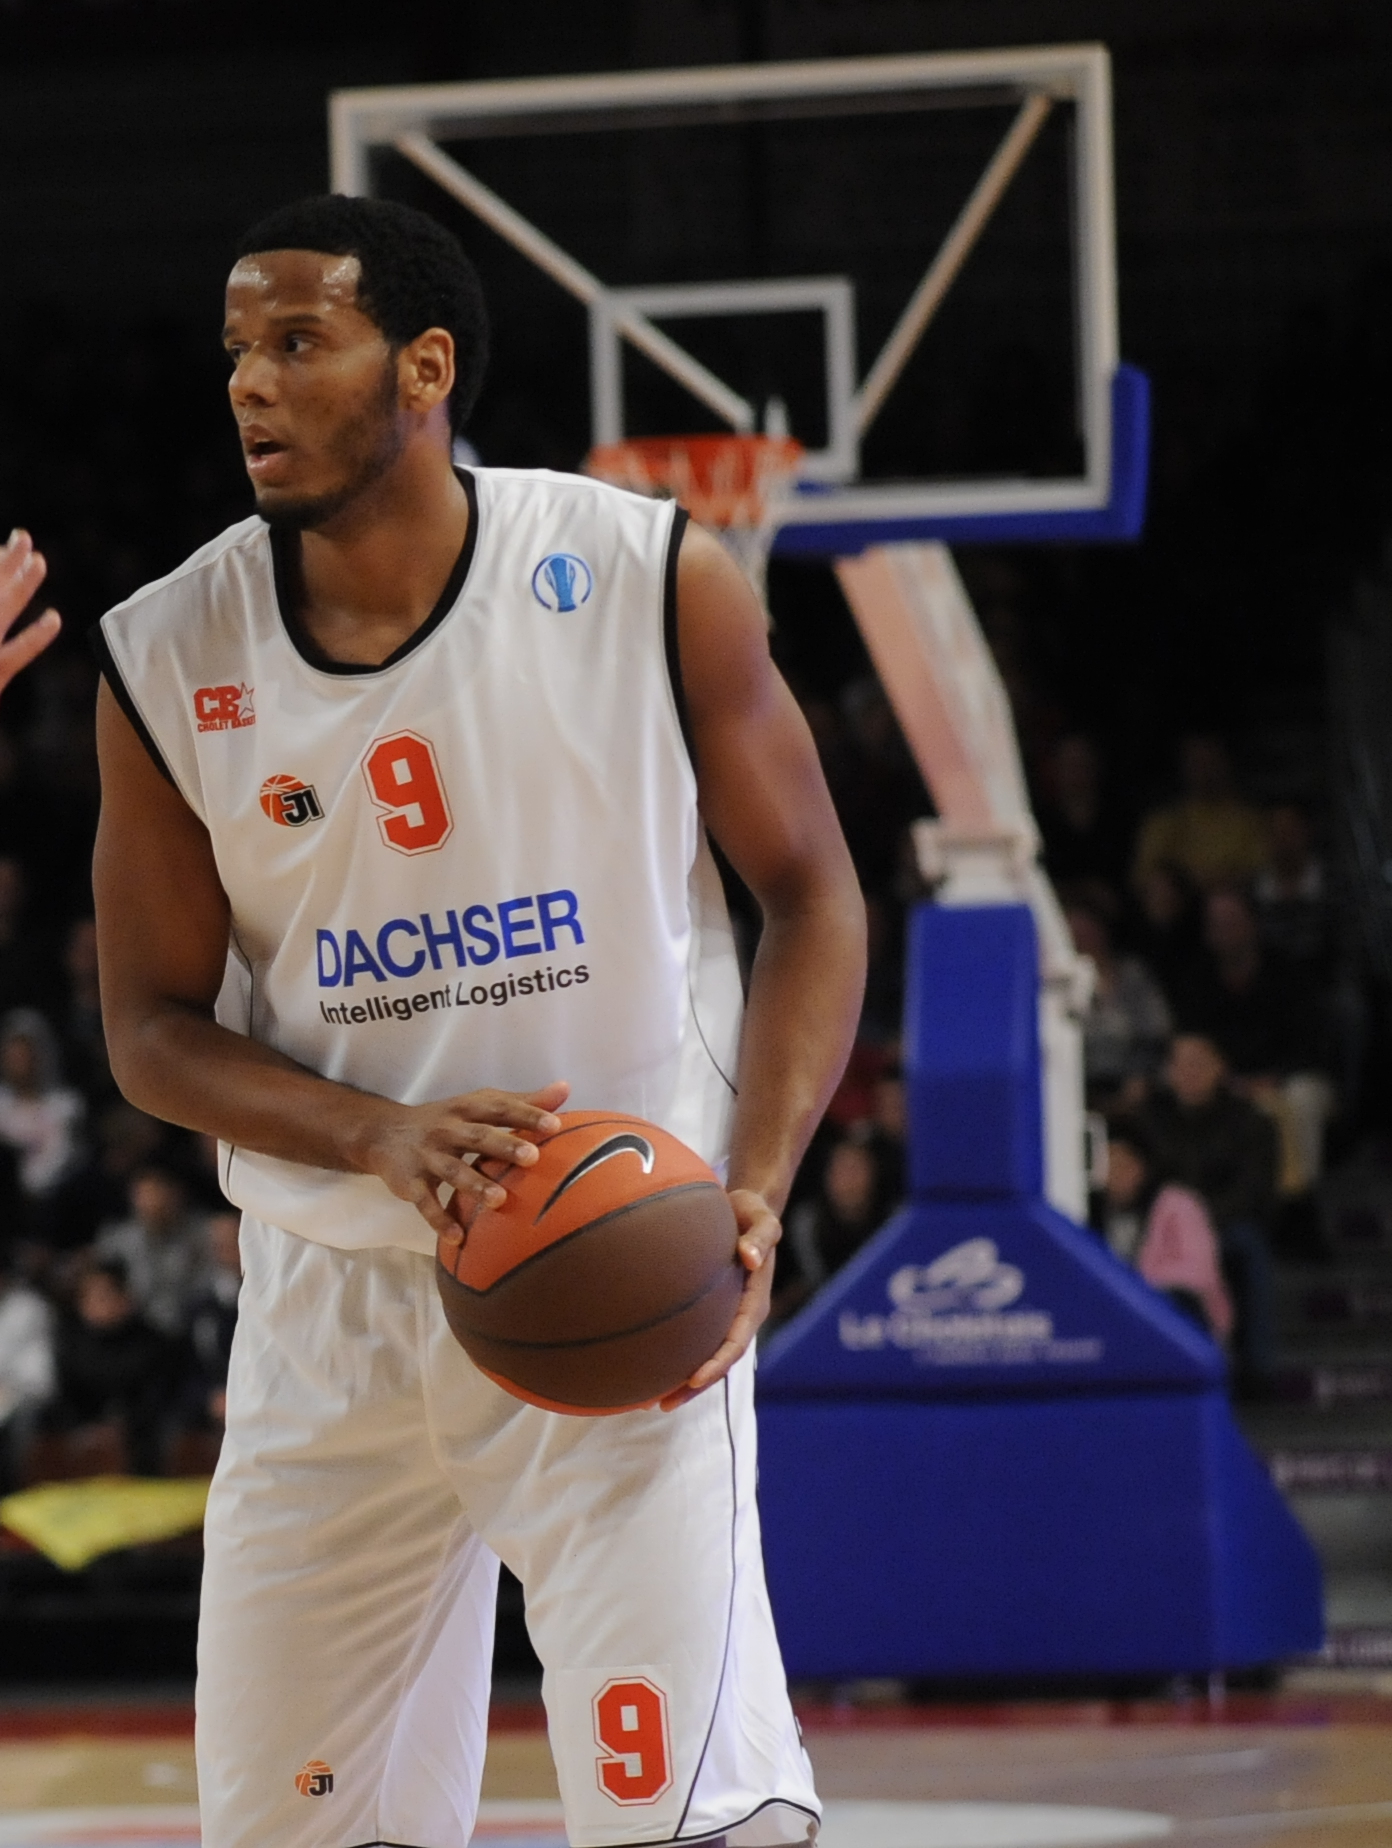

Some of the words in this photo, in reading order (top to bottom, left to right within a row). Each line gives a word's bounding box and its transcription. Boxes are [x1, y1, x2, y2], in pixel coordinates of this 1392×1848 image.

[193, 684, 243, 722] CB
[361, 728, 454, 857] 9
[316, 889, 586, 988] DACHSER
[319, 984, 452, 1026] Intelligent
[455, 963, 591, 1007] Logistics
[591, 1676, 674, 1806] 9
